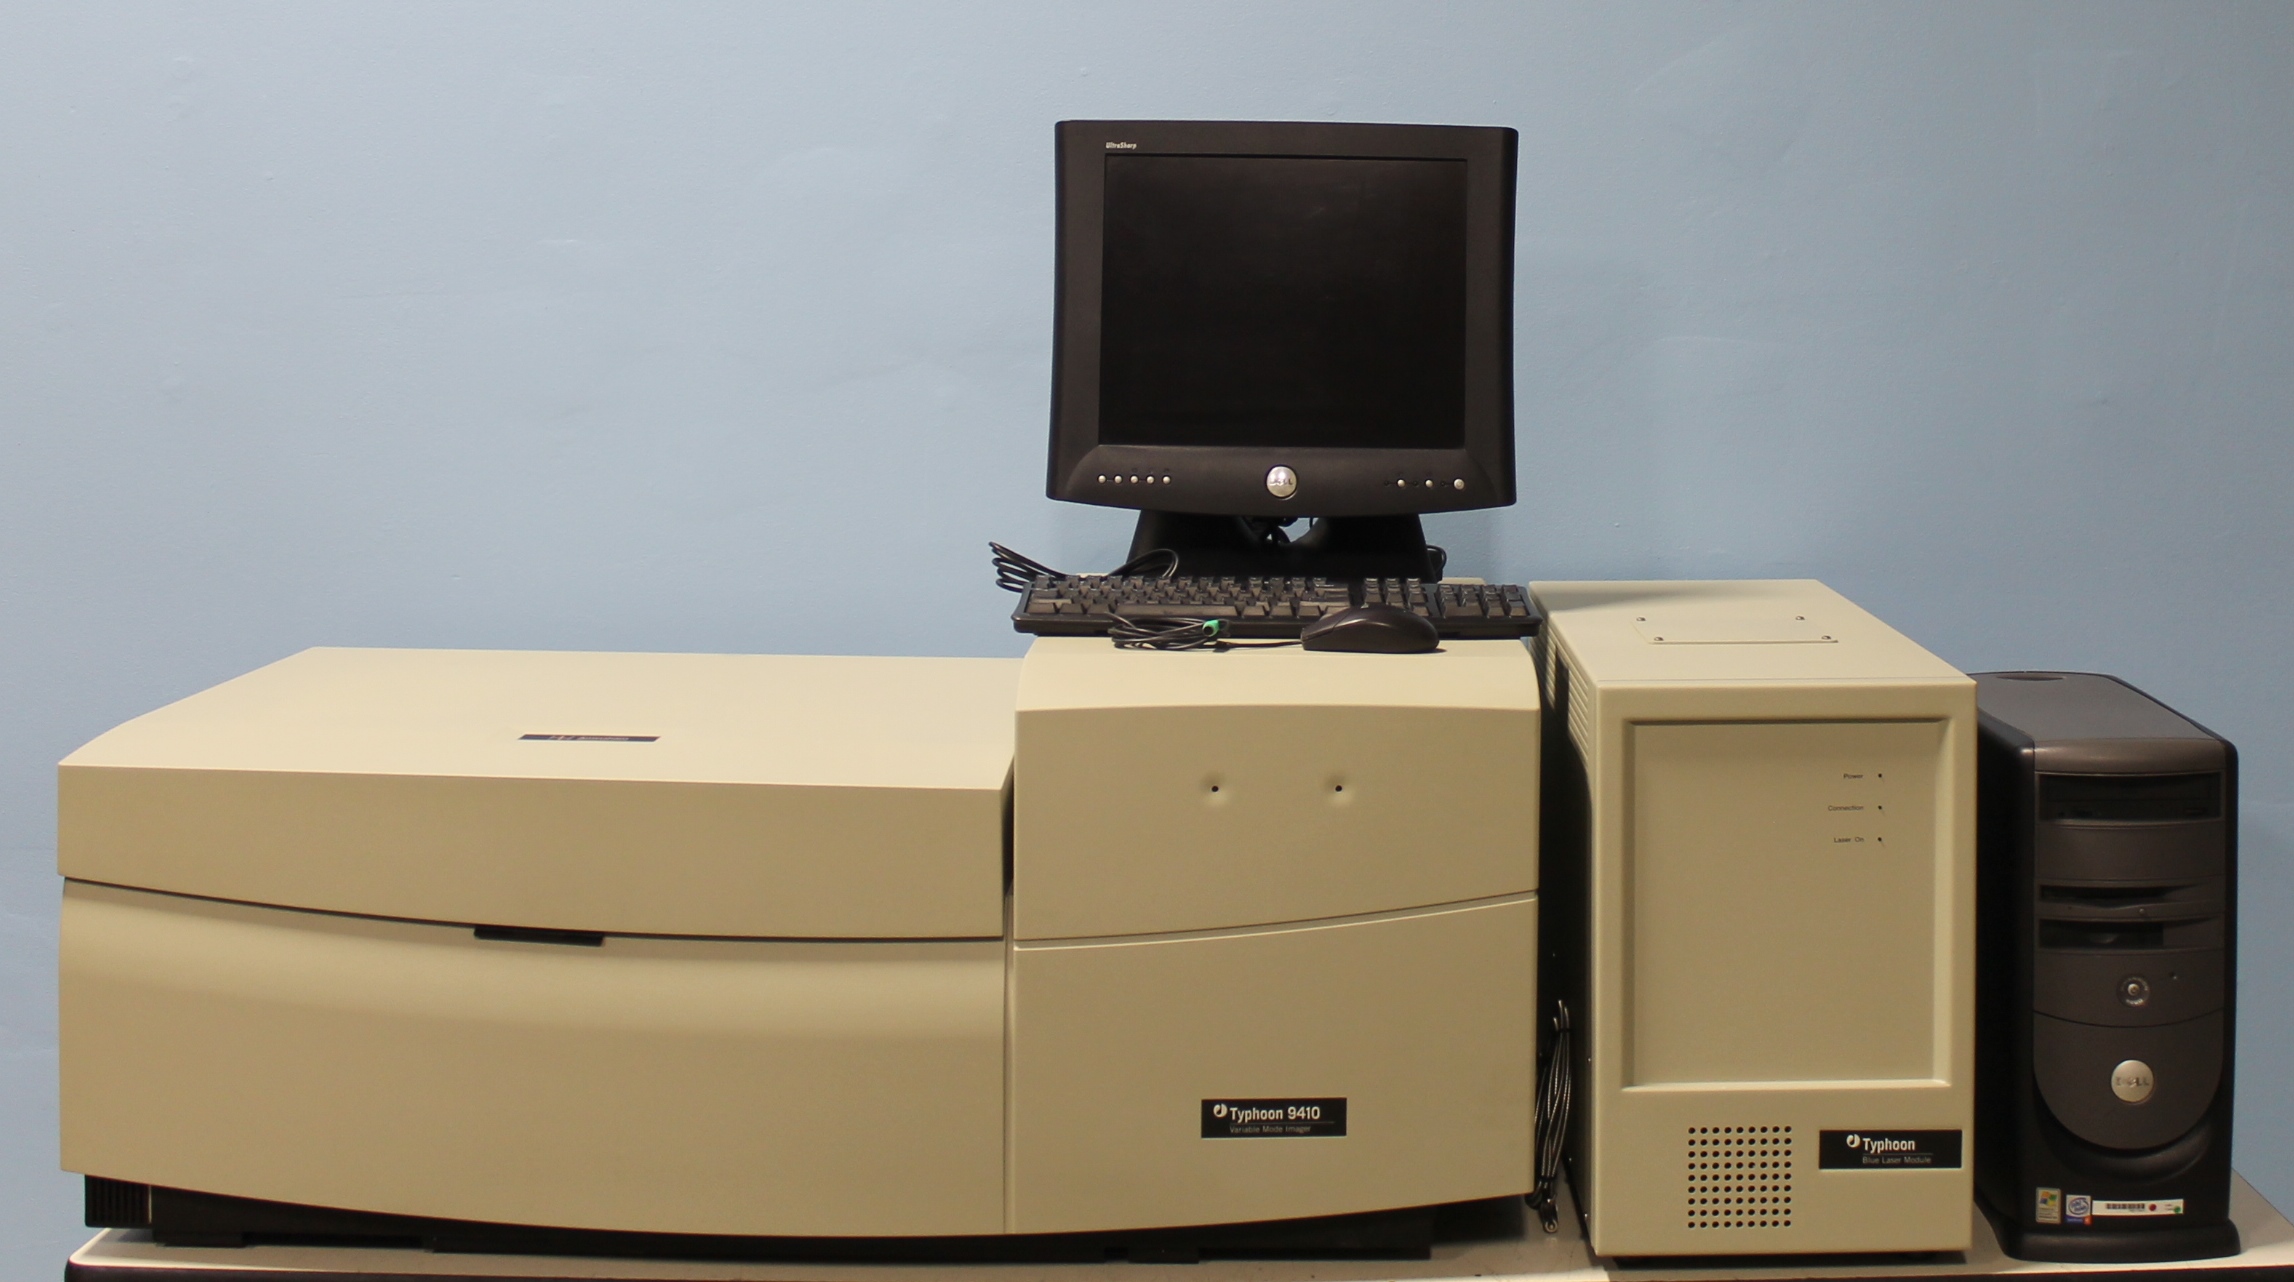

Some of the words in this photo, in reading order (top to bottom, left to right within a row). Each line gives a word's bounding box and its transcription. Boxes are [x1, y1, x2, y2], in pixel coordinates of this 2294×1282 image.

[1229, 1106, 1283, 1123] Typhoon
[1287, 1106, 1320, 1120] 9410
[1229, 1125, 1260, 1133] Variable
[1262, 1125, 1283, 1133] Mode
[1285, 1125, 1312, 1134] Imager
[1862, 1137, 1915, 1154] Typhoon
[1862, 1156, 1880, 1164] Blue
[1881, 1156, 1901, 1164] Laser
[1903, 1155, 1932, 1164] Module
